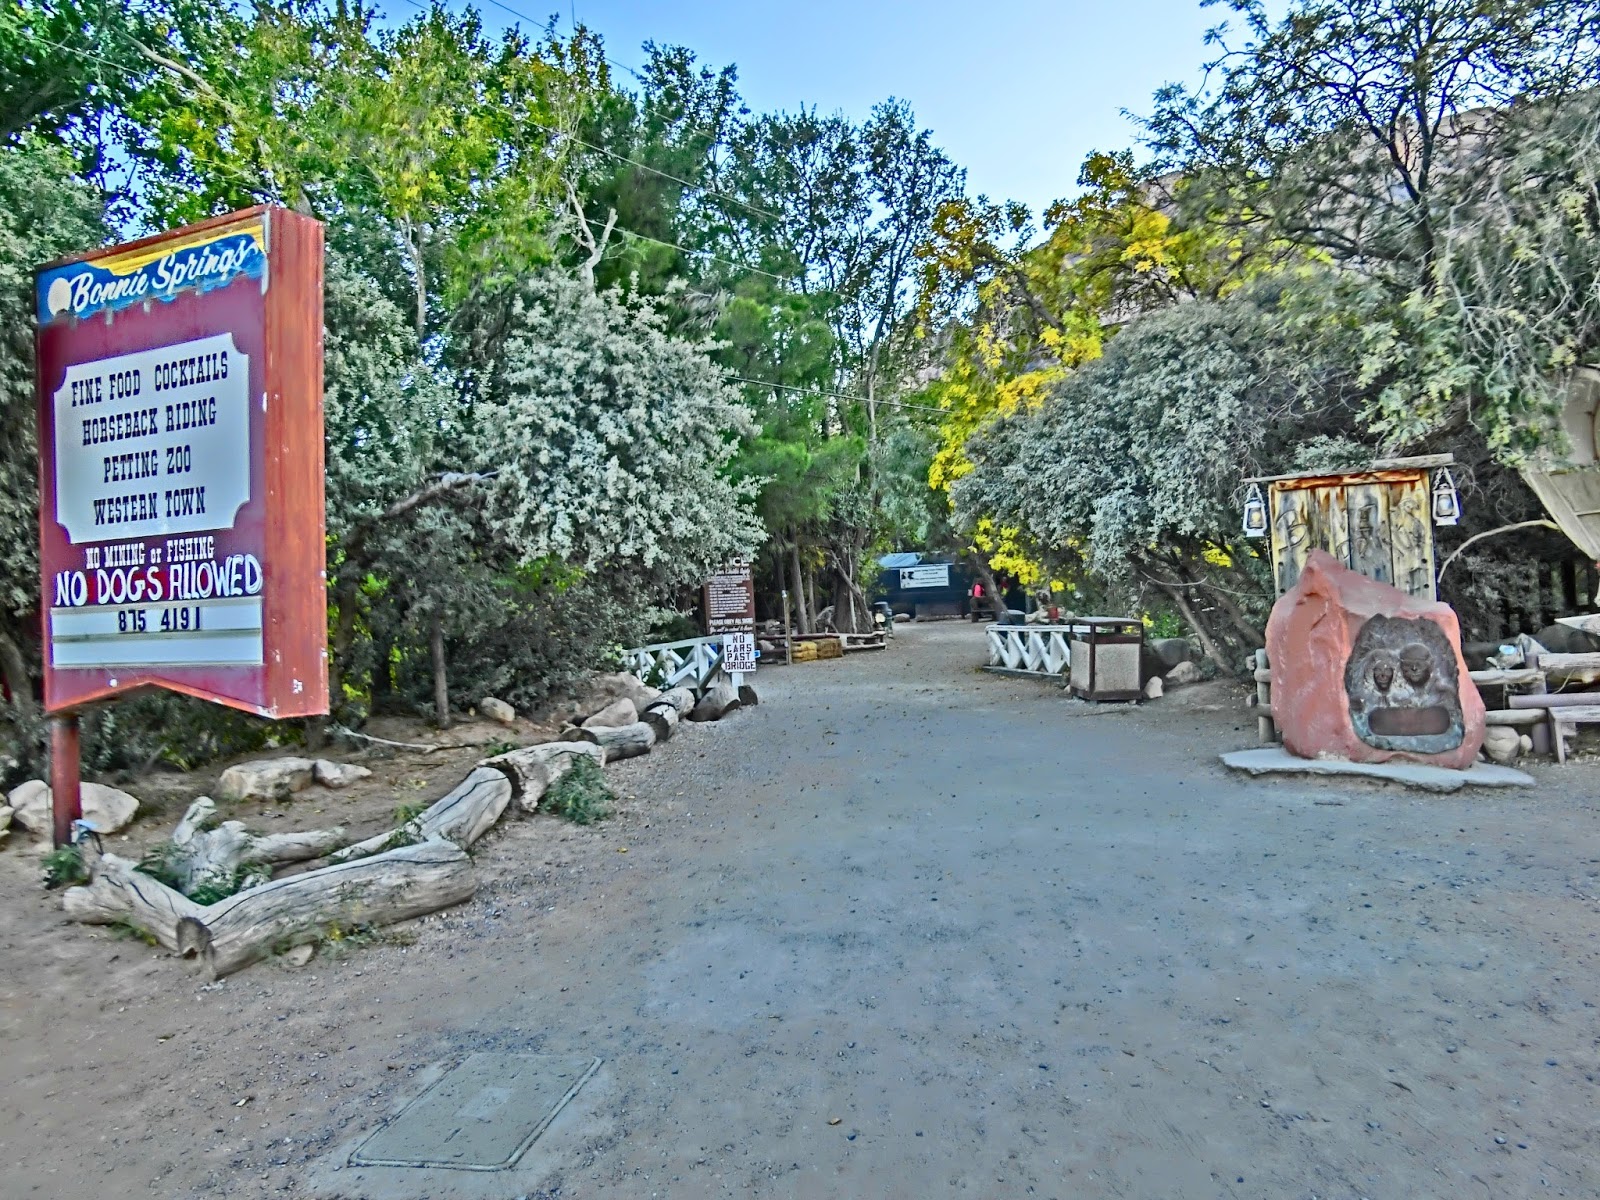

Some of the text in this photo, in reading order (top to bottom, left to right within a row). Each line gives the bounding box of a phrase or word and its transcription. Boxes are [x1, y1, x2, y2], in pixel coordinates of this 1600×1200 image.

[70, 239, 259, 313] Bonnie Springs
[71, 351, 228, 407] FINE FOOD COCKTAILS
[82, 397, 216, 446] HORSEBACK RIDING
[103, 444, 191, 483] PETTING ZOO
[93, 486, 206, 525] WESTERN TOWN
[85, 548, 100, 569] NO
[104, 542, 146, 567] MINING
[166, 536, 214, 562] FISHING
[55, 553, 263, 606] NO DOGS ALLOWED
[118, 607, 200, 632] 875 4191
[726, 644, 752, 653] CARS
[727, 652, 750, 661] PAST
[732, 634, 745, 644] NO
[725, 661, 756, 670] BRIDGE
